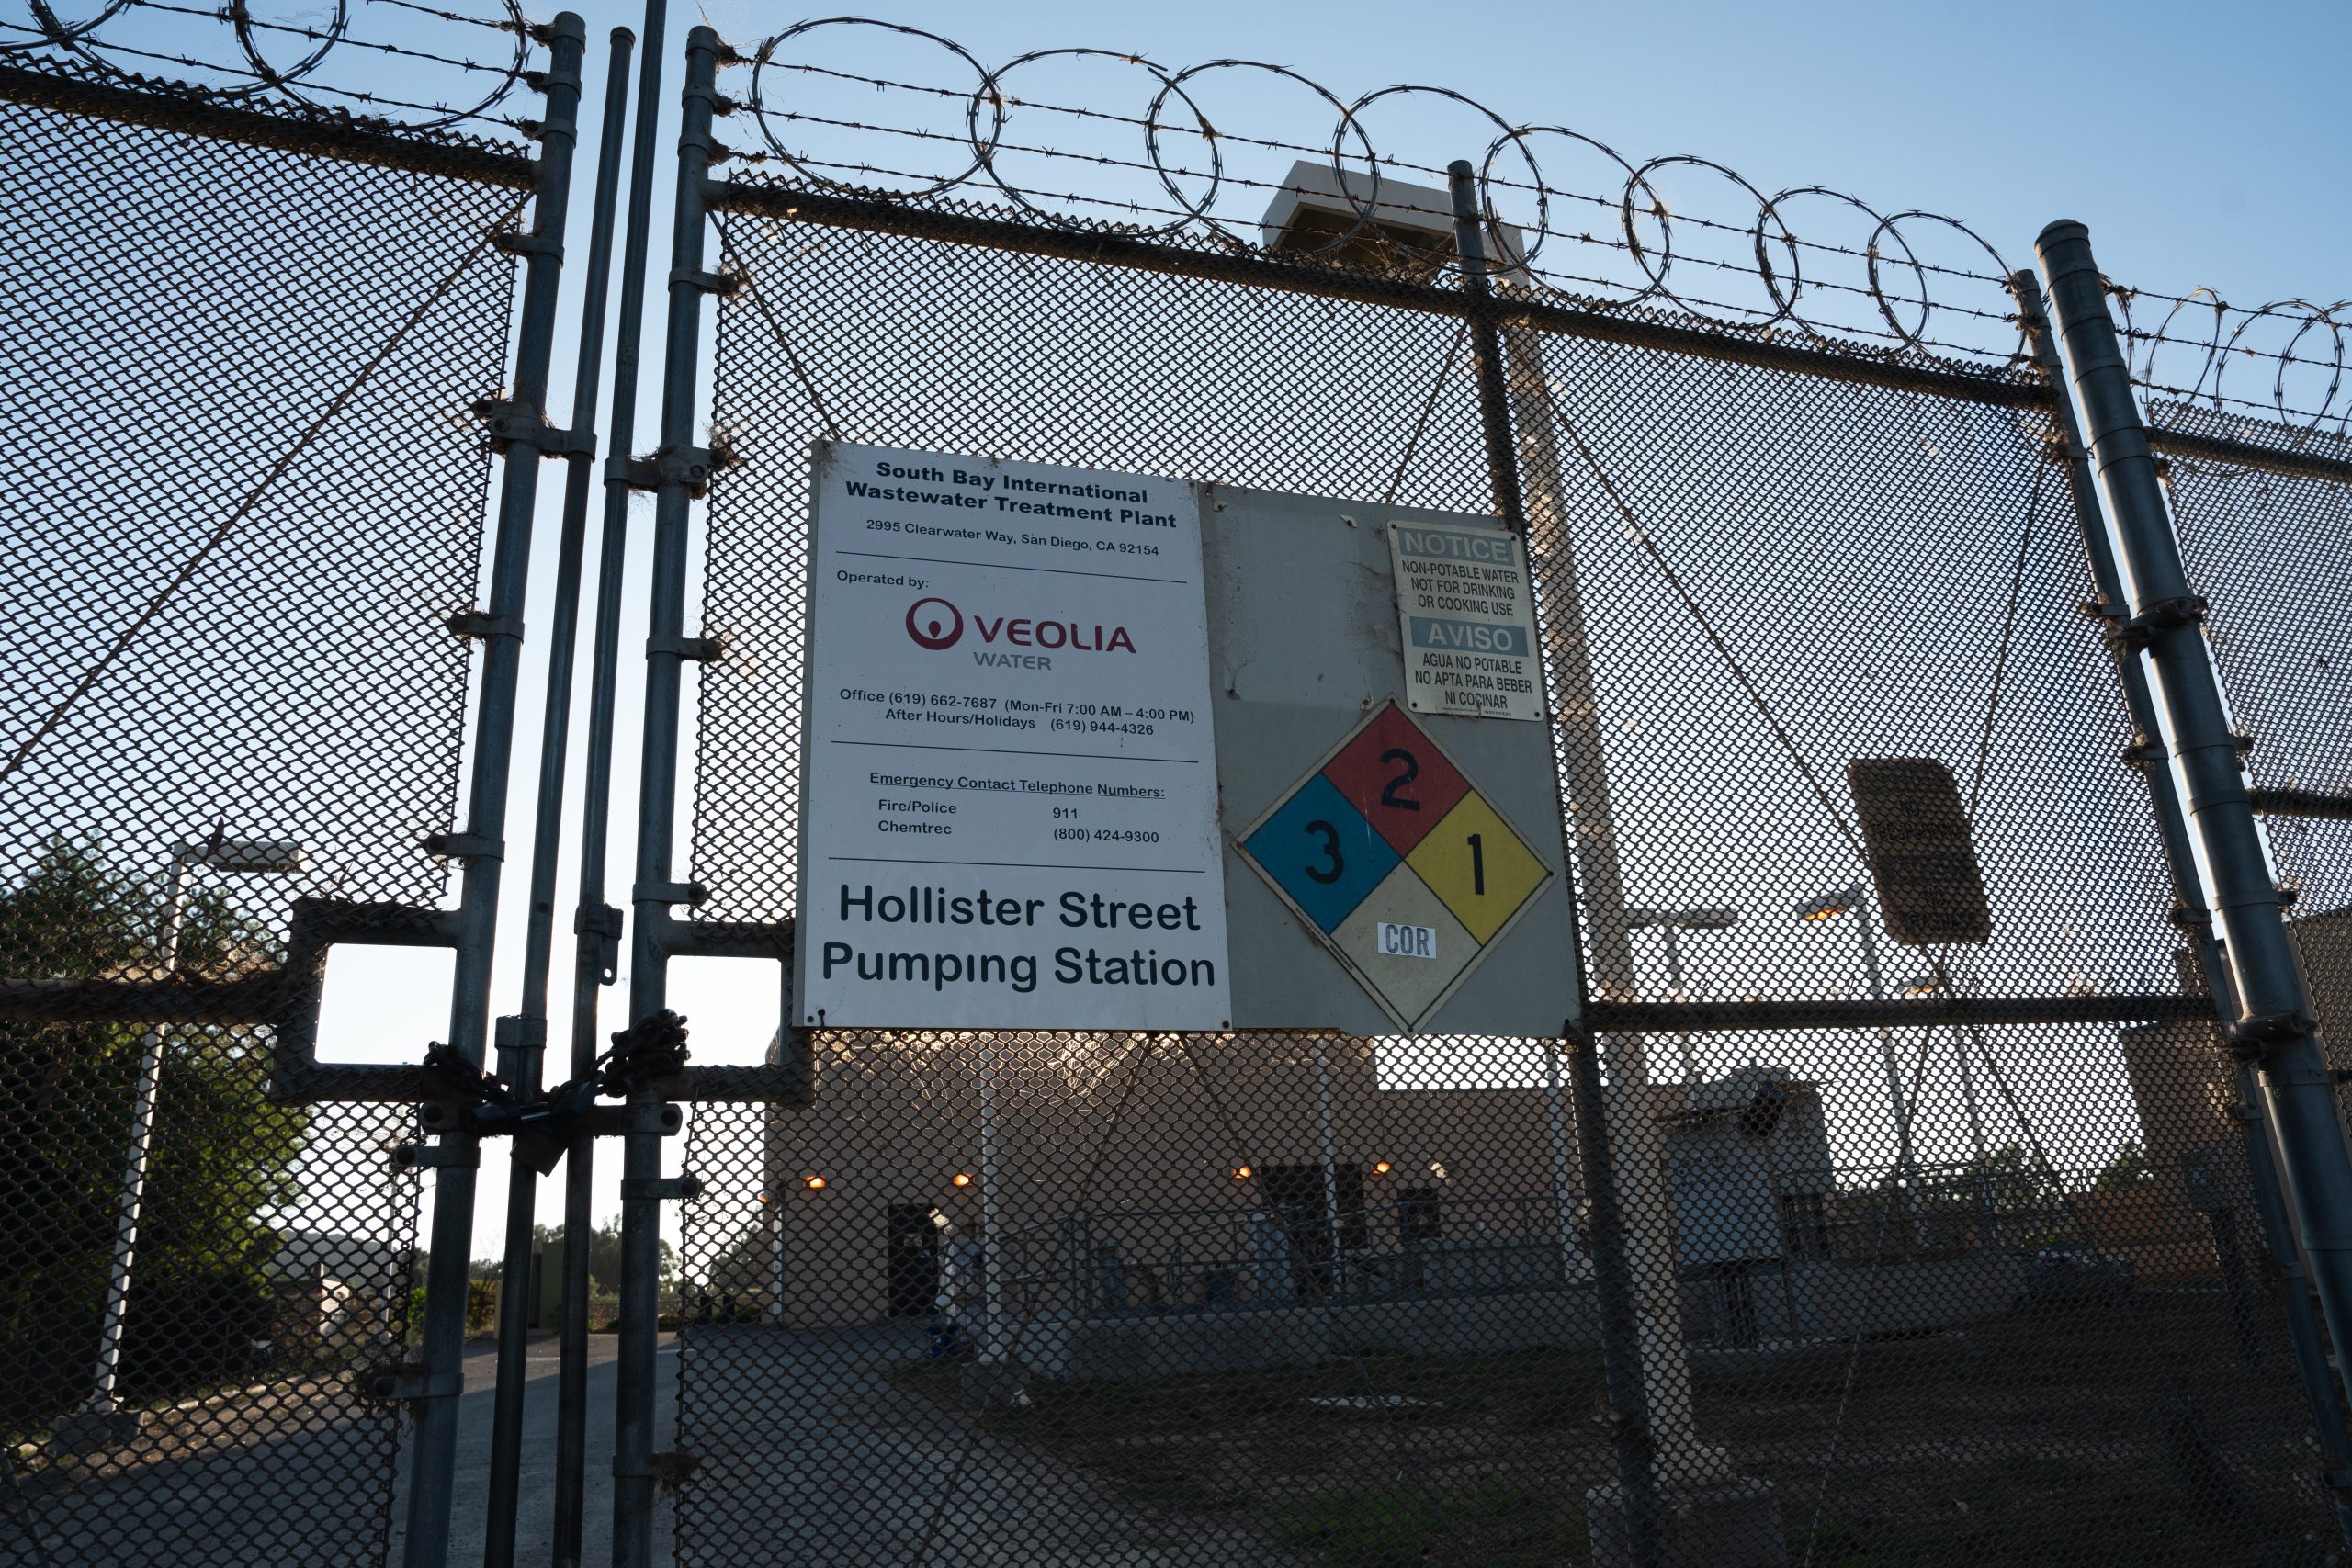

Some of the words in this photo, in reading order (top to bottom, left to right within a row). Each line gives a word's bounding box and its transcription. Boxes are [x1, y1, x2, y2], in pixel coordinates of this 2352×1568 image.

[876, 462, 944, 482] South
[953, 469, 995, 490] Bay
[1004, 475, 1148, 502] International
[846, 481, 987, 509] Wastewater
[995, 496, 1112, 522] Treatment
[1120, 509, 1176, 527] Plant
[866, 520, 900, 532] 2995
[905, 523, 981, 539] Clearwater
[986, 530, 1017, 544] Way,
[1021, 534, 1046, 545] San
[1051, 536, 1092, 551] Diego,
[1097, 541, 1115, 552] CA
[1119, 542, 1159, 556] 92154
[1404, 532, 1509, 562] NOTICE
[836, 570, 904, 588] Operated
[909, 575, 929, 590] by:
[1402, 560, 1479, 580] NON-POTABLE
[1481, 569, 1518, 583] WATER
[1411, 578, 1433, 591] NOT
[1438, 581, 1459, 593] FOR
[1464, 582, 1515, 599] DRINKING
[1419, 595, 1434, 608] OR
[1438, 598, 1488, 614] COOKING
[1492, 604, 1513, 615] USE
[974, 616, 1136, 653] VEOLIA
[1428, 623, 1512, 651] AVISO
[973, 651, 1052, 671] WATER
[1423, 653, 1453, 668] AGUA
[1456, 657, 1471, 670] NO
[1475, 659, 1521, 674] POTABLE
[1415, 671, 1430, 684] NO
[1435, 673, 1463, 687] APTA
[1466, 676, 1493, 690] PARA
[1497, 679, 1532, 694] BEBER
[840, 689, 885, 704] Office
[889, 692, 926, 707] (619)
[930, 695, 997, 709] 662-7687
[1004, 699, 1062, 714] (Mon-Fri
[1067, 702, 1095, 716] 7:00
[1101, 705, 1122, 717] AM
[1136, 707, 1165, 719] 4:00
[1170, 709, 1194, 724] PM)
[1445, 691, 1455, 704] NI
[1459, 693, 1507, 708] COCINAR
[886, 708, 922, 721] After
[926, 711, 1035, 729] Hours/Holidays
[1050, 718, 1086, 733] (619)
[1091, 721, 1153, 735] 944-4326
[869, 773, 953, 789] Emergency
[957, 777, 1015, 791] Contact
[1020, 780, 1092, 795] Telephone
[1097, 784, 1164, 797] Numbers:
[1380, 749, 1419, 811] 2
[878, 799, 956, 815] Fire/Police
[1053, 807, 1078, 819] 911
[878, 820, 952, 834] Chemtrec
[1054, 828, 1090, 842] (800)
[1094, 830, 1159, 843] 424-9300
[1305, 820, 1343, 884] 3
[1467, 834, 1484, 895] 1
[841, 885, 1045, 926] Hollister
[1059, 892, 1200, 931] Street
[1385, 925, 1430, 955] COR
[823, 942, 1037, 992] Pumping
[1055, 947, 1214, 986] Station
